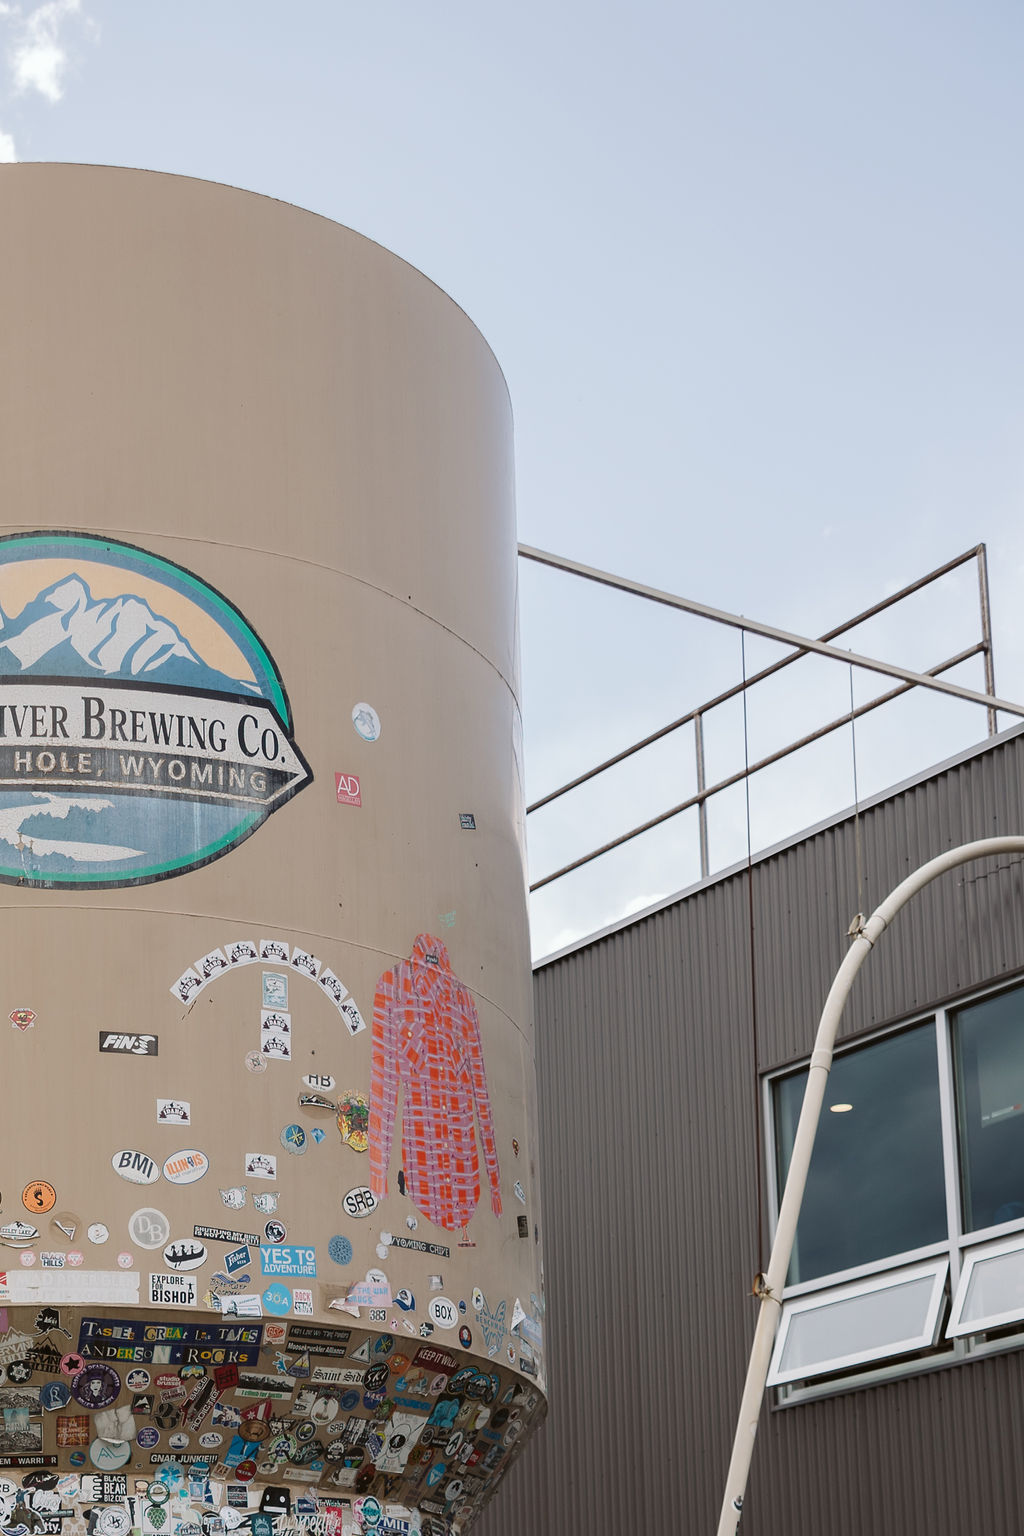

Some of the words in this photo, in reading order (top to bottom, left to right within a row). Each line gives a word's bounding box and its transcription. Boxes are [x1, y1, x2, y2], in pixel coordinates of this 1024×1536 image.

[81, 696, 228, 752] BREWING
[13, 751, 105, 778] HOLE,
[120, 755, 267, 792] WYOMING
[119, 1152, 154, 1178] BMI
[346, 1190, 375, 1213] SRB
[261, 1248, 292, 1264] YES
[295, 1249, 315, 1265] TO
[264, 1264, 316, 1275] ADVENTURE!
[152, 1275, 184, 1285] EXPLORE
[152, 1290, 195, 1304] BISHOP
[369, 1310, 386, 1321] 383
[435, 1304, 452, 1321] BOX
[418, 1349, 434, 1362] KEEP
[314, 1369, 341, 1381] Saint
[151, 1454, 175, 1463] GNAR
[104, 1483, 126, 1495] BEAR
